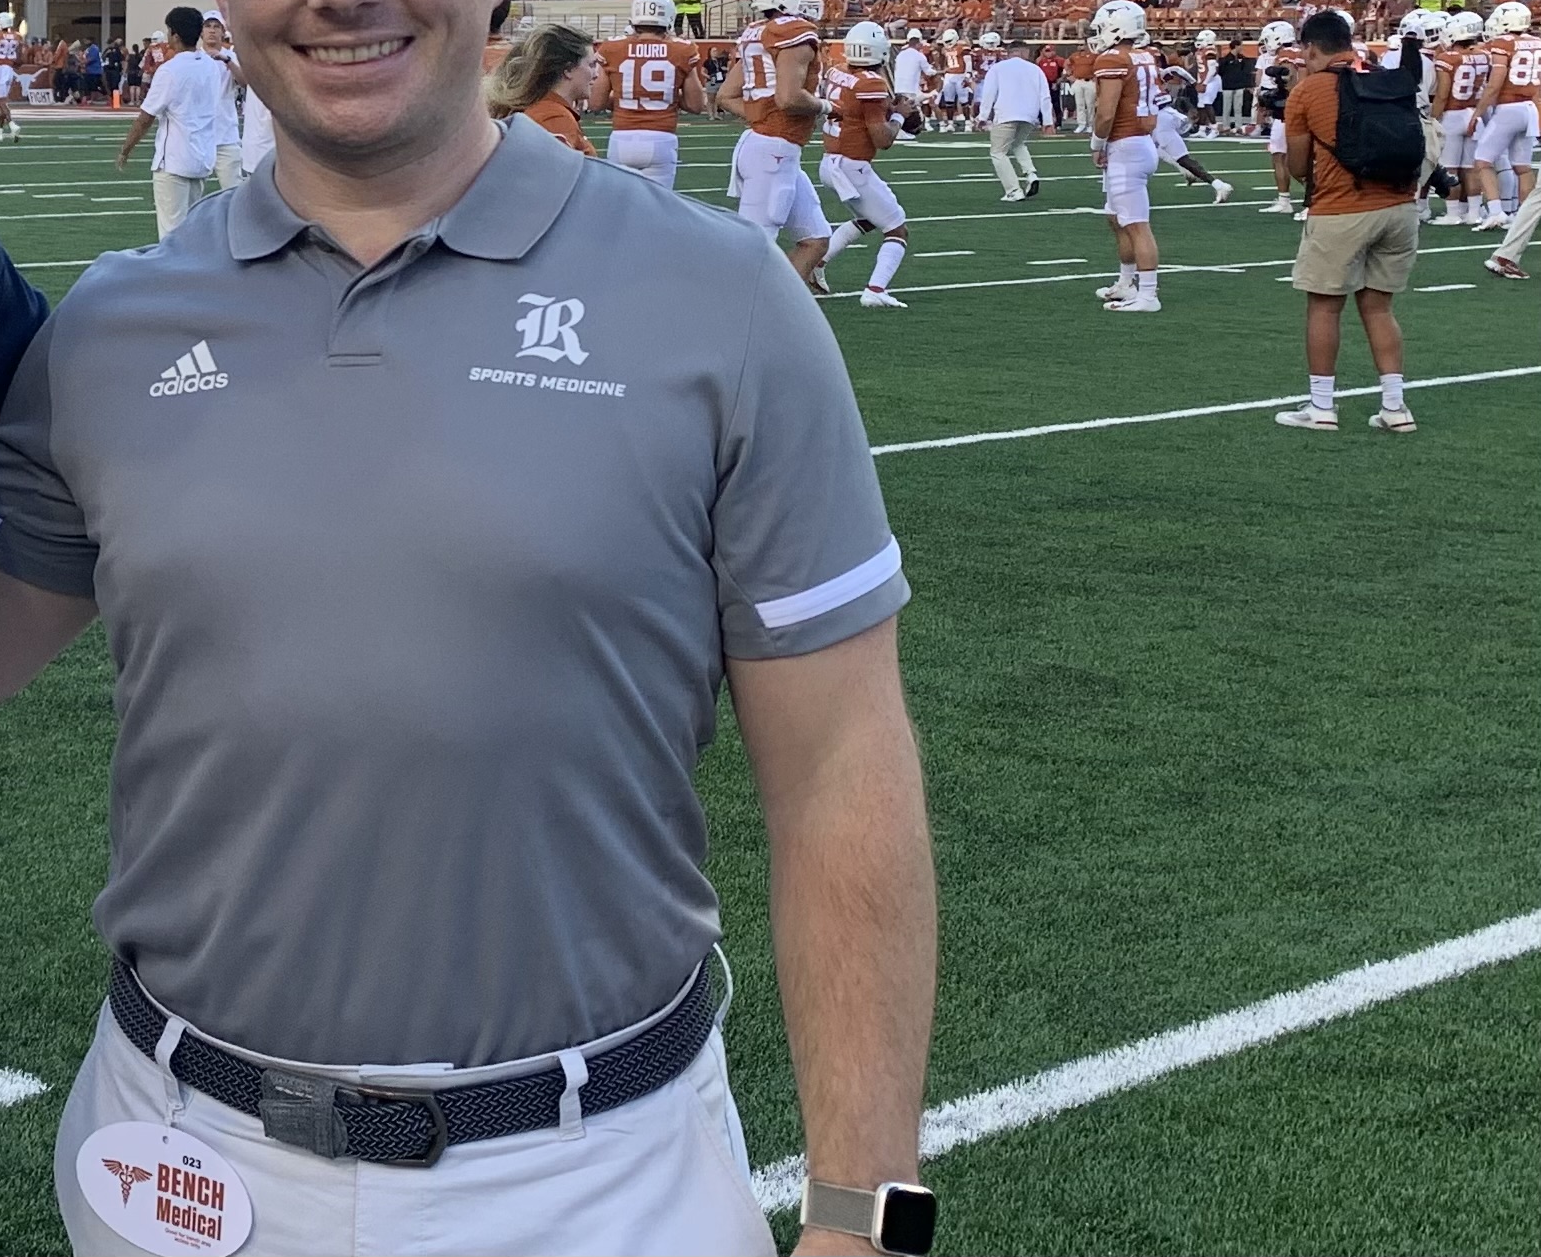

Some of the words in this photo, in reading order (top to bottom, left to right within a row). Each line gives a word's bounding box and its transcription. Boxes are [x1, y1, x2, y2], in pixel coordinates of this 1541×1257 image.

[642, 2, 657, 16] 19
[628, 43, 668, 58] LOURD
[619, 59, 676, 111] 19
[149, 372, 229, 397] adidas
[469, 367, 537, 387] SPORTS
[540, 376, 627, 397] MEDICINE
[182, 1155, 202, 1170] 023
[157, 1162, 225, 1212] BENCH
[156, 1194, 222, 1242] Medical
